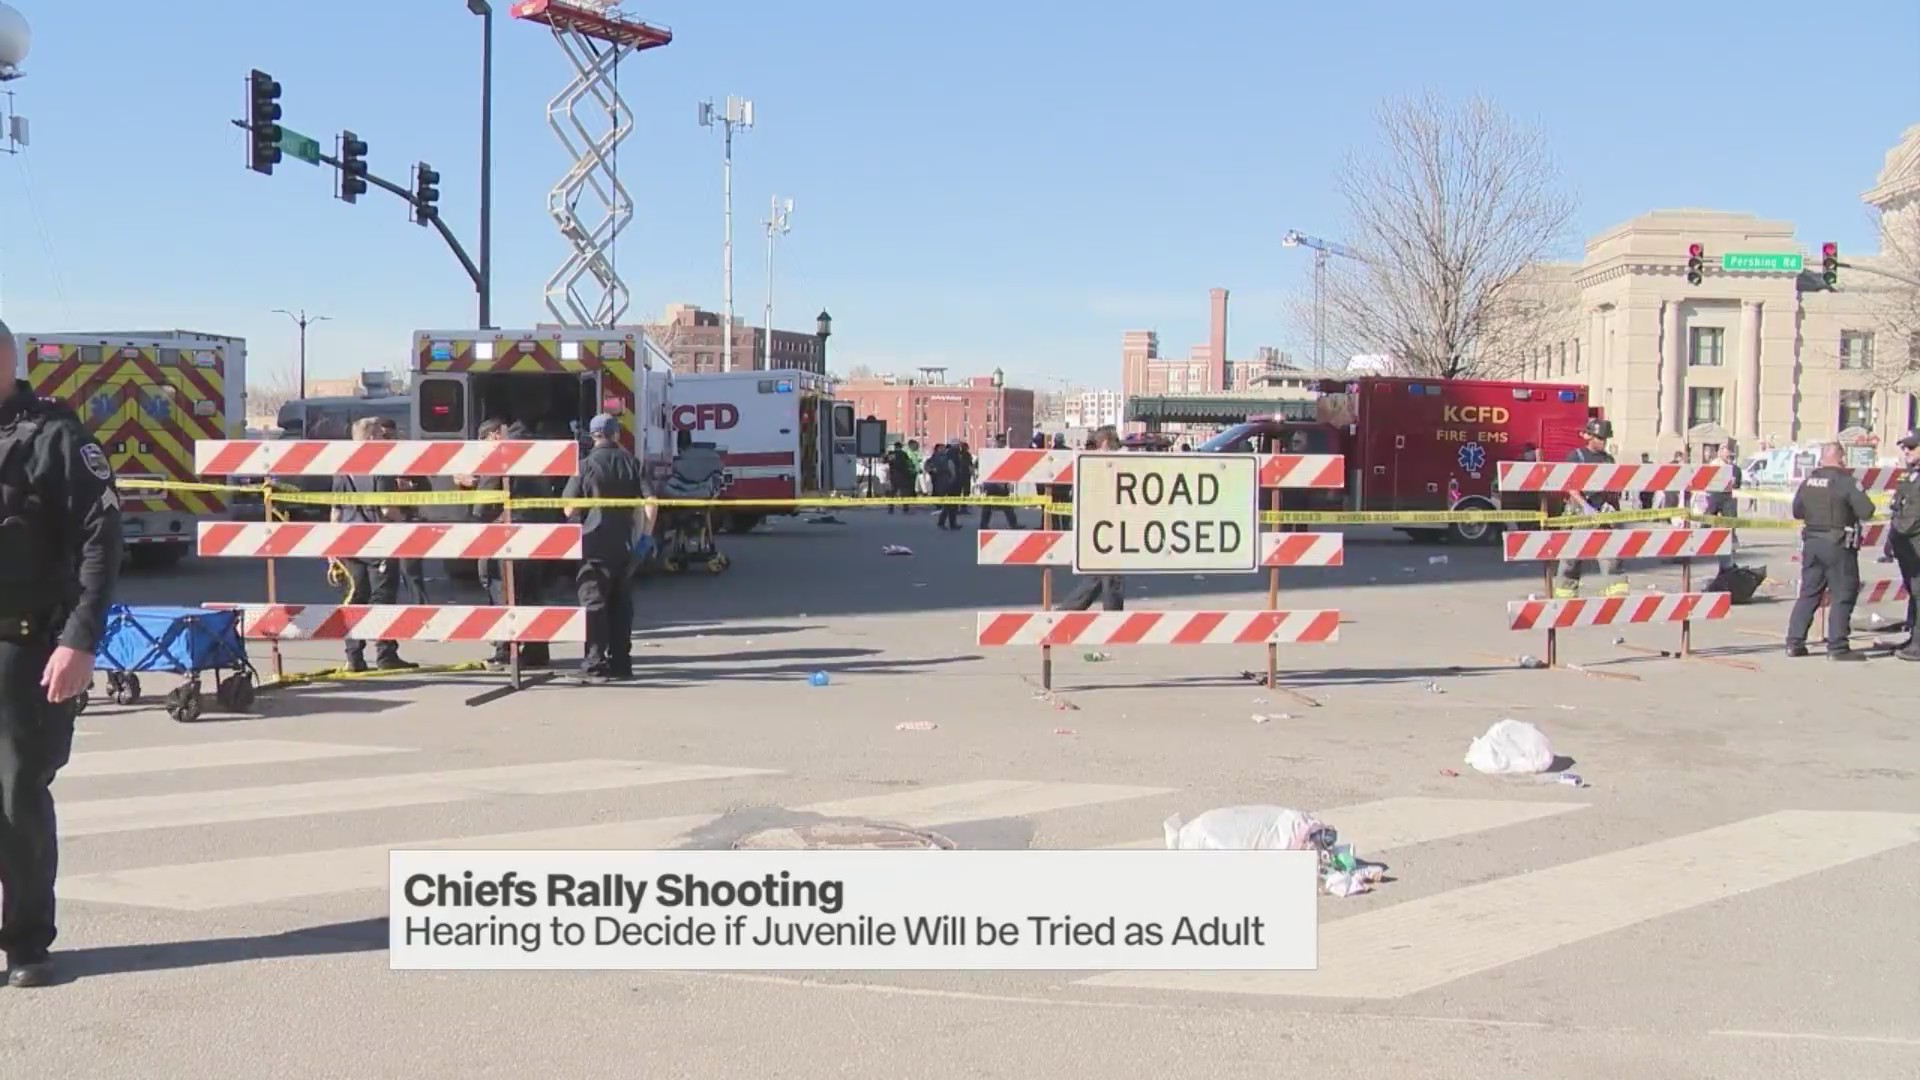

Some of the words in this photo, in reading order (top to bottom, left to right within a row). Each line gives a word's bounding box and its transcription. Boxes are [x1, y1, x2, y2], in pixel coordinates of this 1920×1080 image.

[1730, 256, 1777, 268] Pershing
[1783, 257, 1797, 268] Rd
[1443, 405, 1510, 424] KCFD
[1436, 430, 1467, 442] FIRE
[1478, 431, 1509, 443] EMS
[1116, 472, 1219, 506] ROAD
[1092, 519, 1241, 555] CLOSED
